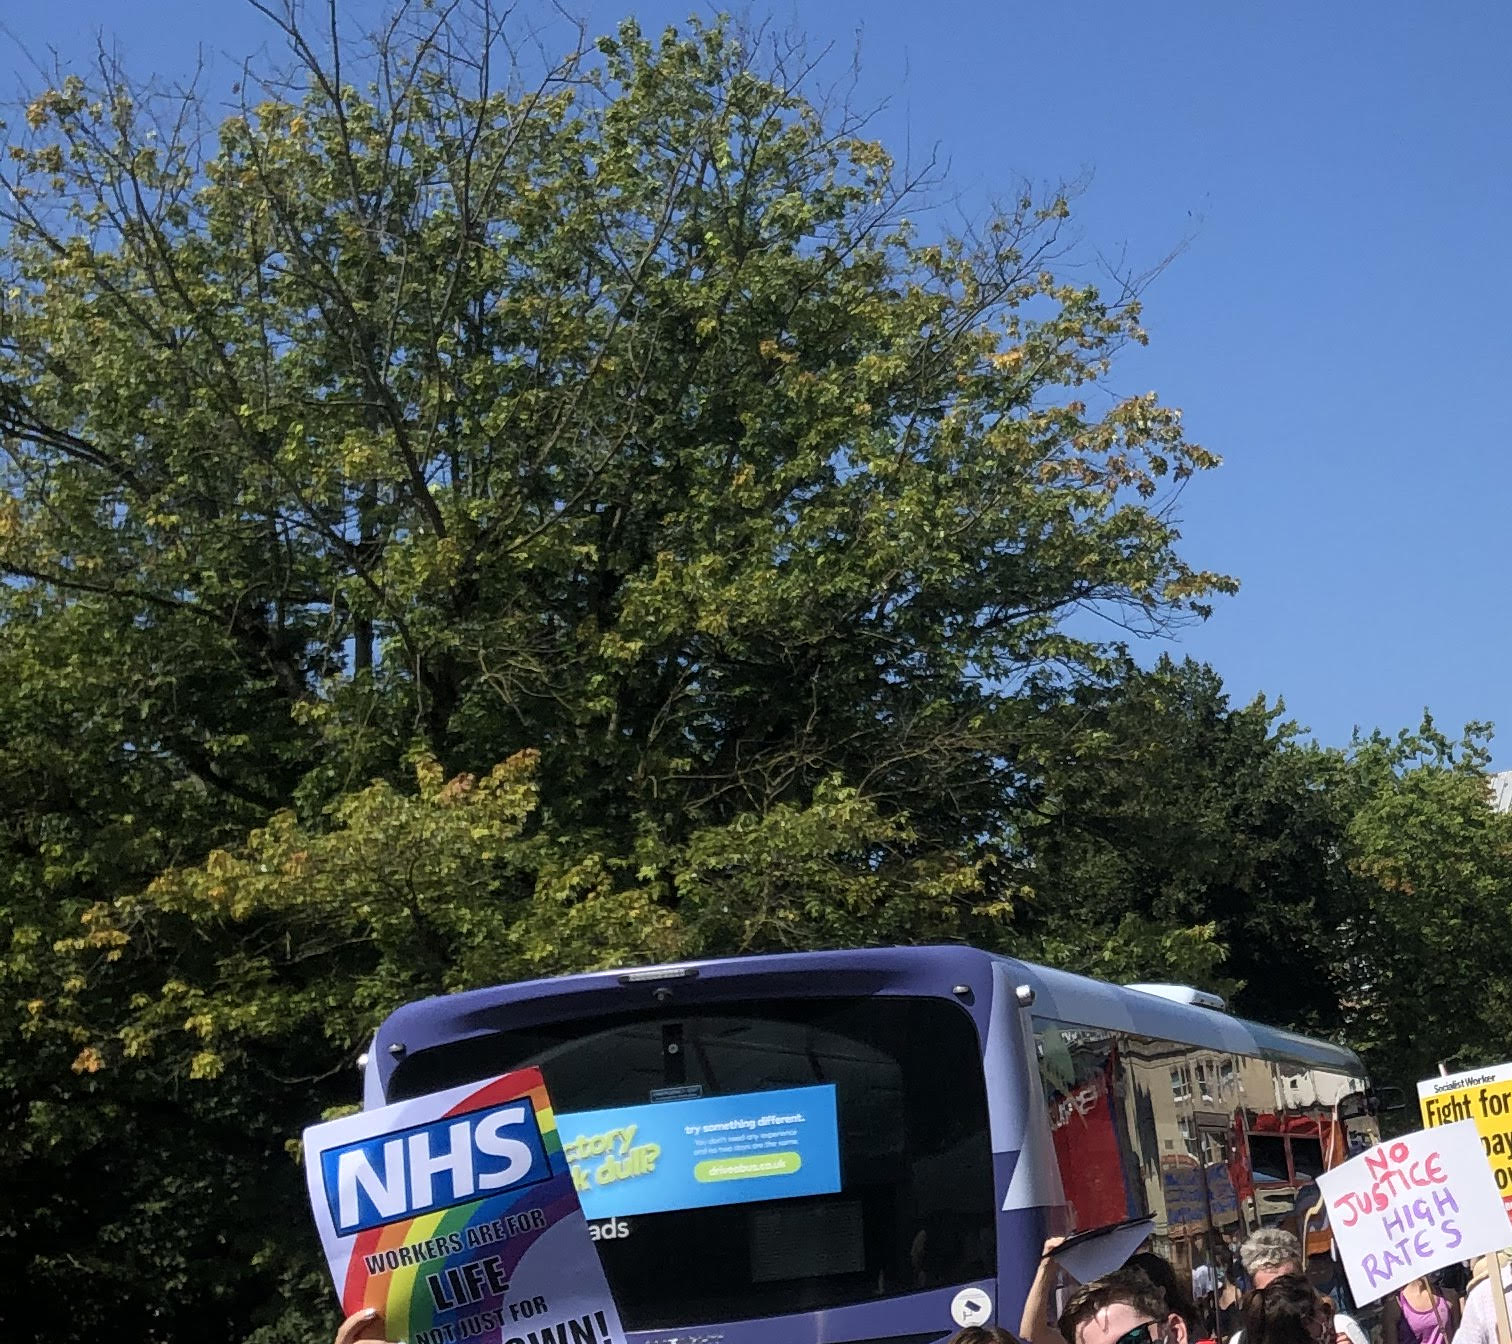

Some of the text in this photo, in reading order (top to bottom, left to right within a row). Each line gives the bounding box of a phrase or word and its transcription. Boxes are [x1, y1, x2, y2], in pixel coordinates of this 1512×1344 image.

[1434, 1075, 1496, 1094] Socialist Worker
[684, 1113, 806, 1136] try something different.
[1425, 1089, 1512, 1128] Fight for
[339, 1107, 533, 1229] NHS
[595, 1142, 661, 1186] dull?
[1364, 1142, 1410, 1180] NO
[1334, 1152, 1448, 1227] JUSTICE
[1382, 1187, 1459, 1240] HIGH
[365, 1208, 547, 1277] WORKERS ARE FOR
[425, 1255, 510, 1312] LIFE
[459, 1311, 504, 1341] JUST
[509, 1295, 549, 1324] FOR
